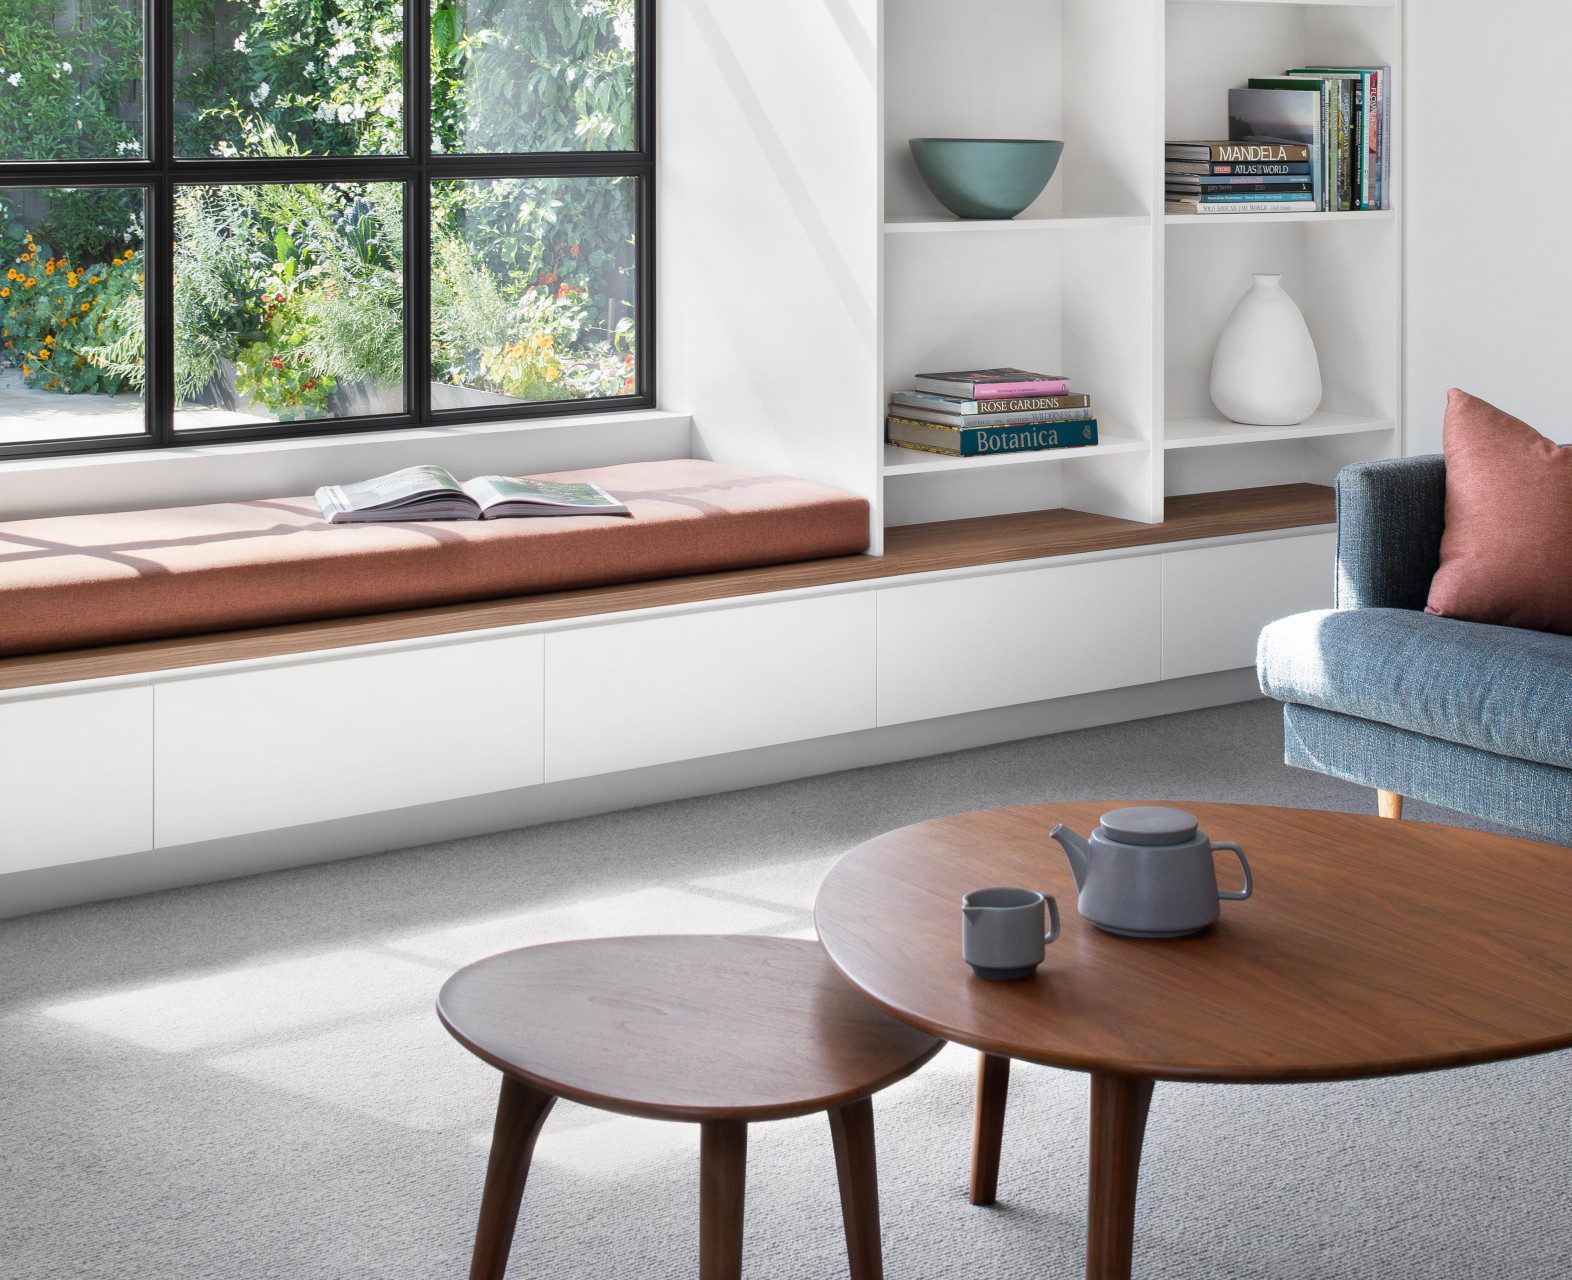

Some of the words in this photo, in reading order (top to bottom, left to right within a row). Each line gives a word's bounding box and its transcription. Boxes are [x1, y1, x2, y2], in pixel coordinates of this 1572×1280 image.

[1219, 146, 1287, 161] MANDELA
[1234, 166, 1256, 174] ATLAS
[1263, 166, 1289, 174] WORLD
[980, 402, 1007, 412] ROSE
[1010, 398, 1059, 410] GARDENS
[1031, 410, 1072, 421] WILDERNESS
[976, 426, 1059, 452] Botanica
